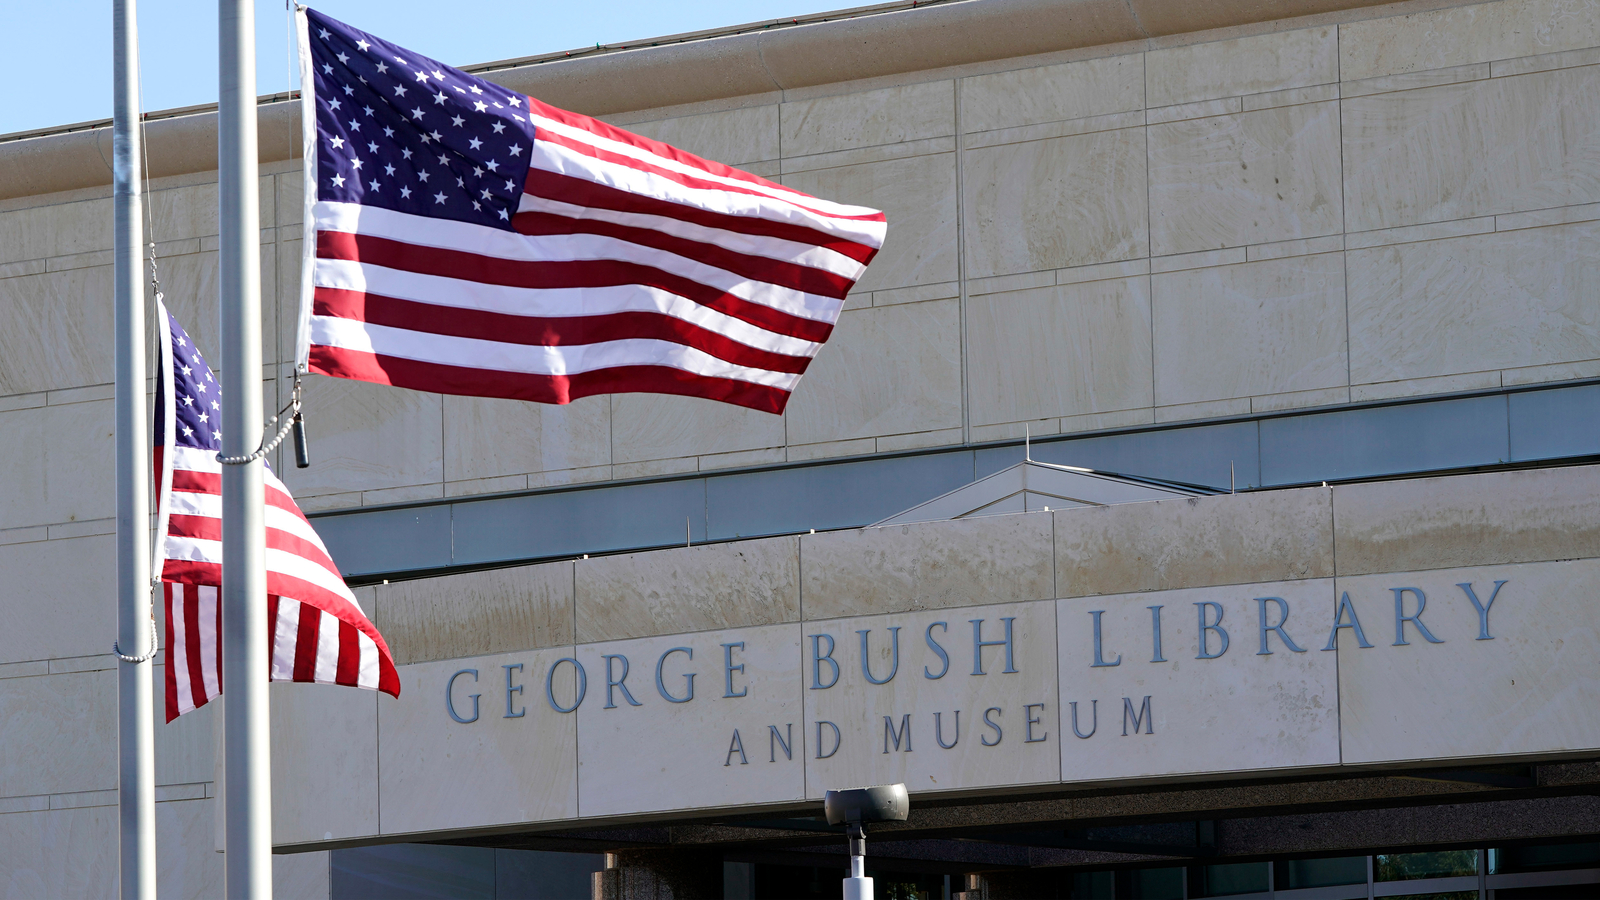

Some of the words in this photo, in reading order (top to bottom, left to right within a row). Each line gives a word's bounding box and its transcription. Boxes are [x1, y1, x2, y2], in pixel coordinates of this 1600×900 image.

[445, 640, 749, 724] GEORGE
[809, 616, 1019, 690] BUSH
[1088, 579, 1509, 668] LIBRARY
[723, 720, 842, 767] AND
[882, 694, 1155, 755] MUSEUM
